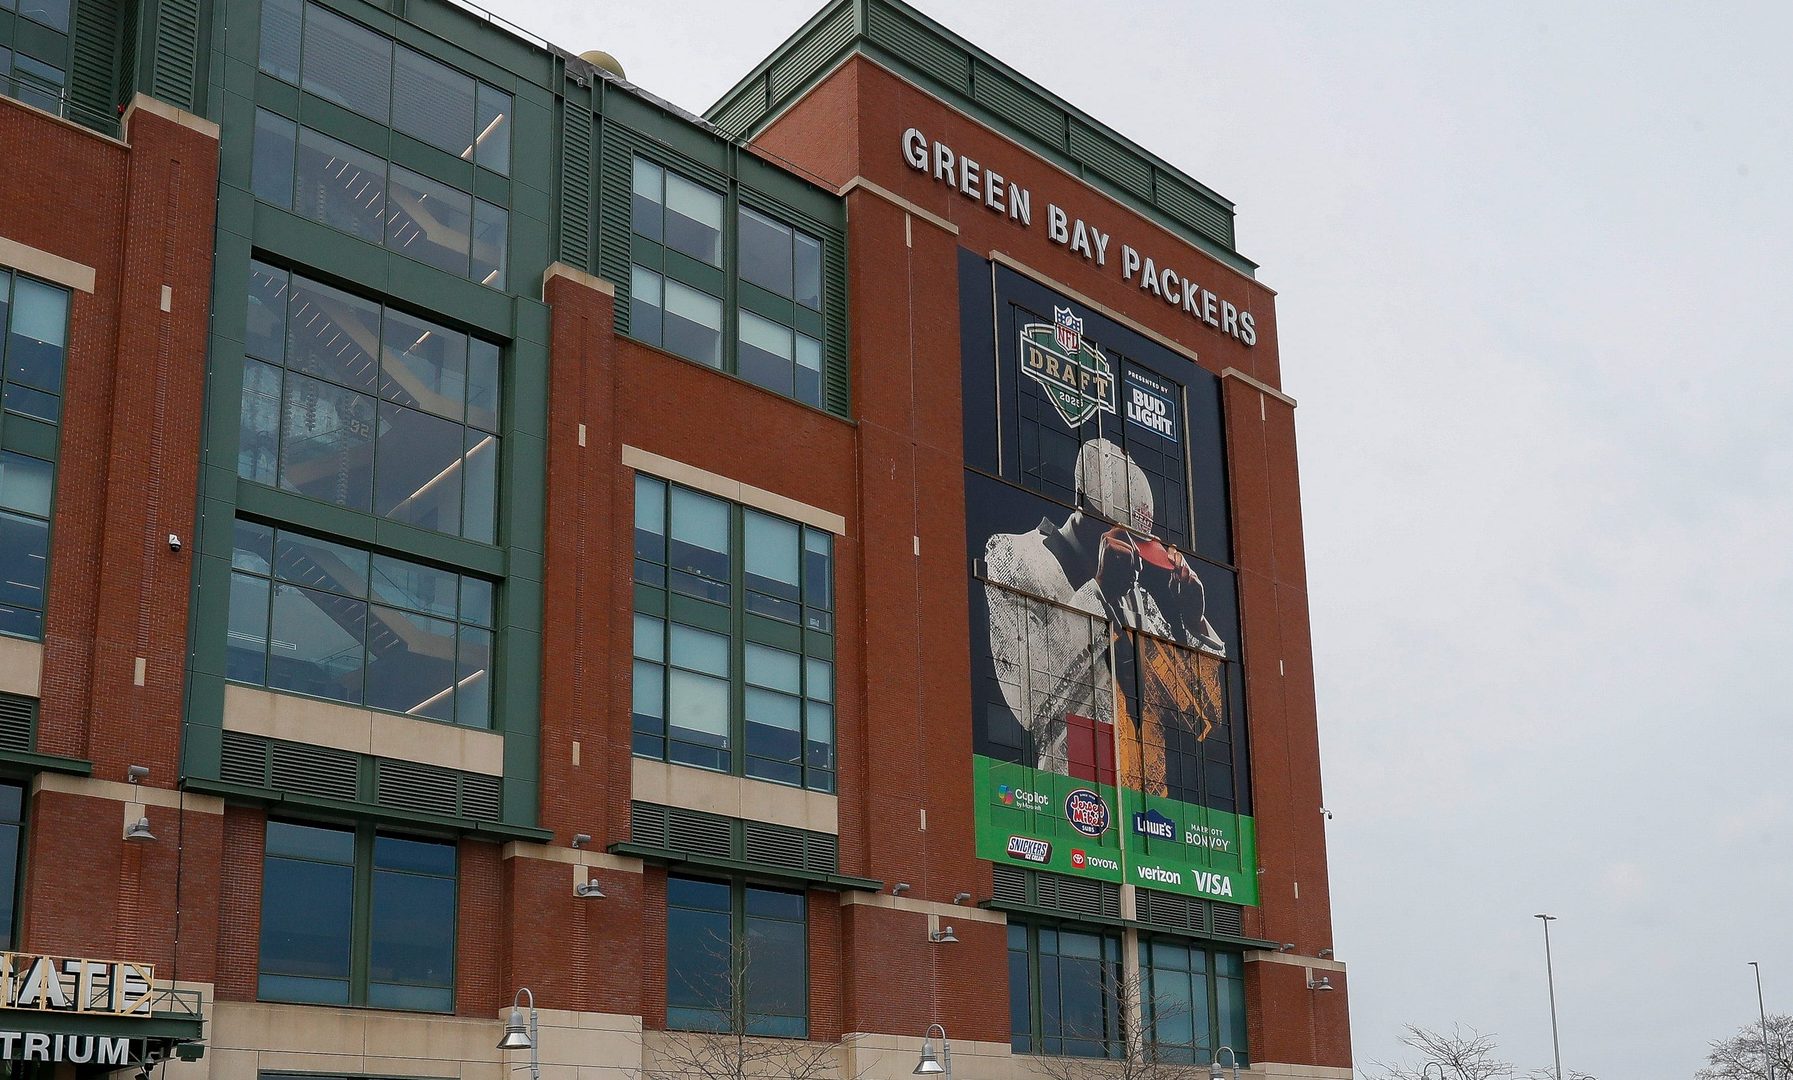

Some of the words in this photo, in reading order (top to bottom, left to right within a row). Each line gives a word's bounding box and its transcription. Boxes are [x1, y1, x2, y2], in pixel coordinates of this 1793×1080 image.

[901, 127, 1032, 227] GREEN
[1047, 203, 1110, 266] BAY
[1122, 244, 1257, 347] PACKERS
[1057, 325, 1079, 350] NFL
[1029, 346, 1109, 398] DRAFT
[1128, 370, 1160, 390] PRESENTED
[1160, 385, 1169, 394] BY
[1059, 391, 1084, 408] 2025
[1132, 387, 1166, 417] BUD
[1127, 401, 1173, 436] LIGHT
[1015, 788, 1049, 806] Copilot
[1071, 795, 1105, 818] Jersey
[1009, 837, 1047, 857] SNICKERS
[1185, 831, 1229, 852] BONVOY
[1087, 856, 1119, 871] TOYOTA
[1137, 865, 1181, 885] verizon
[1191, 869, 1233, 898] VISA
[0, 955, 151, 1013] ATE
[0, 1031, 130, 1066] TRIUM
